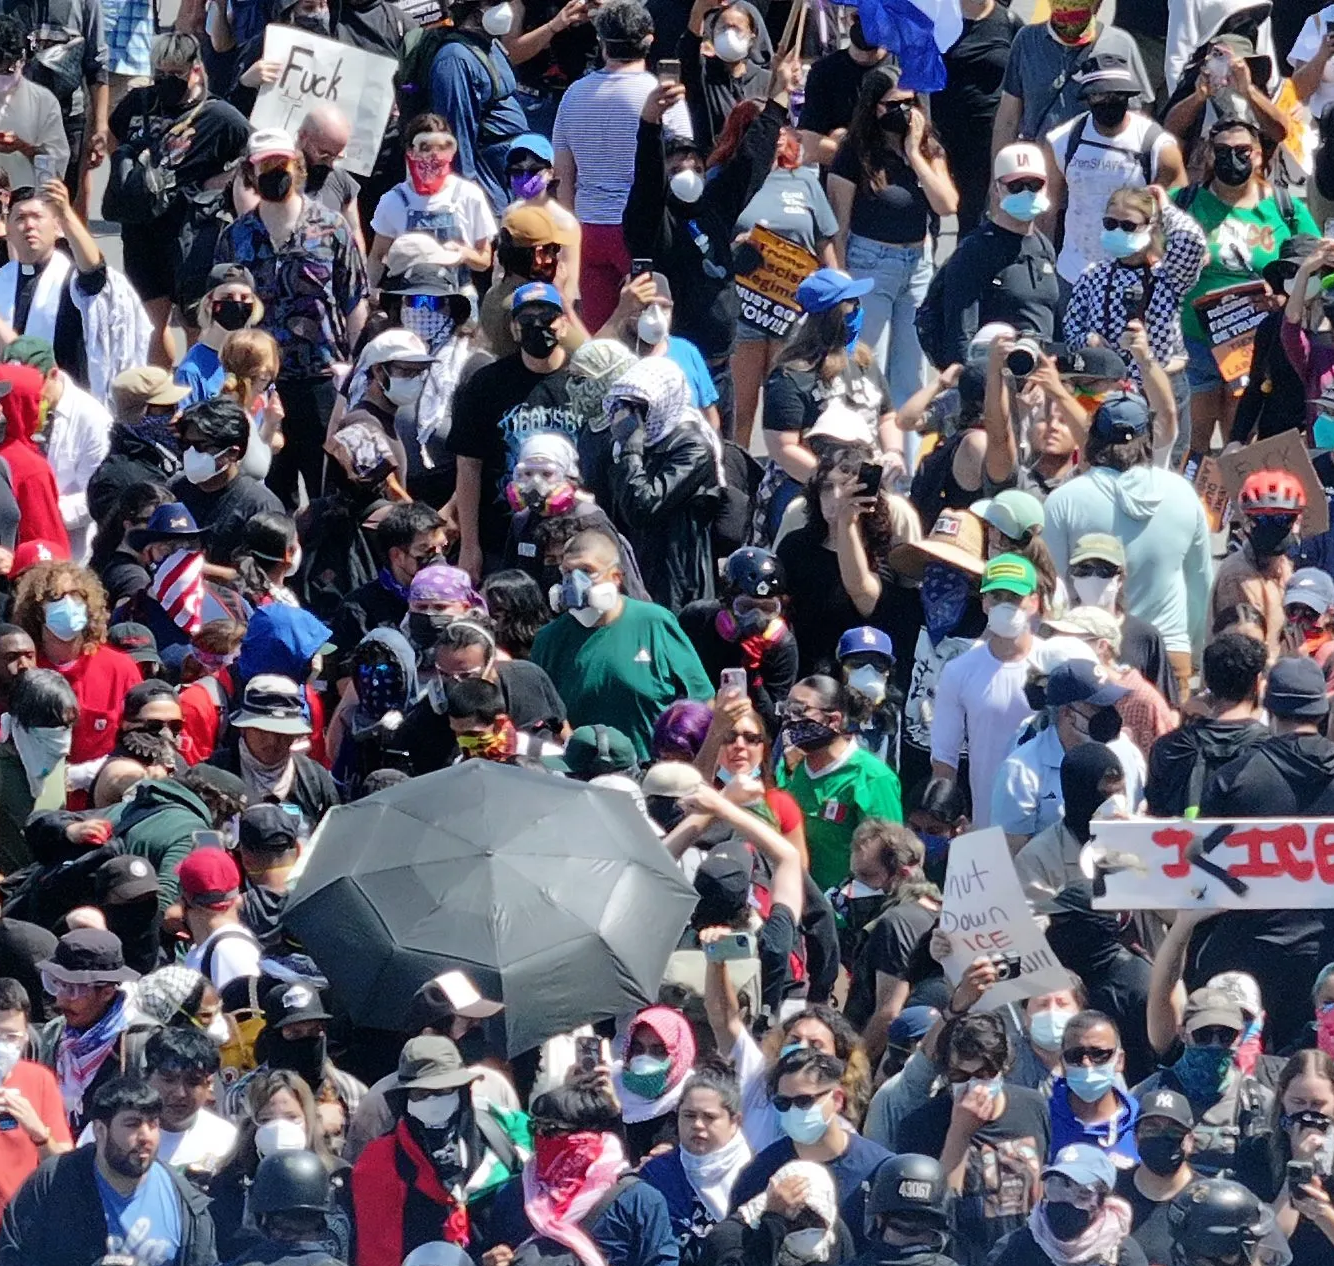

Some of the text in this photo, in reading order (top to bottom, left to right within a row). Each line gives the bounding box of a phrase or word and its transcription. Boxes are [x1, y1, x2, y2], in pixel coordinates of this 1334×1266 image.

[279, 45, 344, 101] Fuck
[741, 303, 791, 336] OW!!!
[963, 930, 1014, 952] ICE
